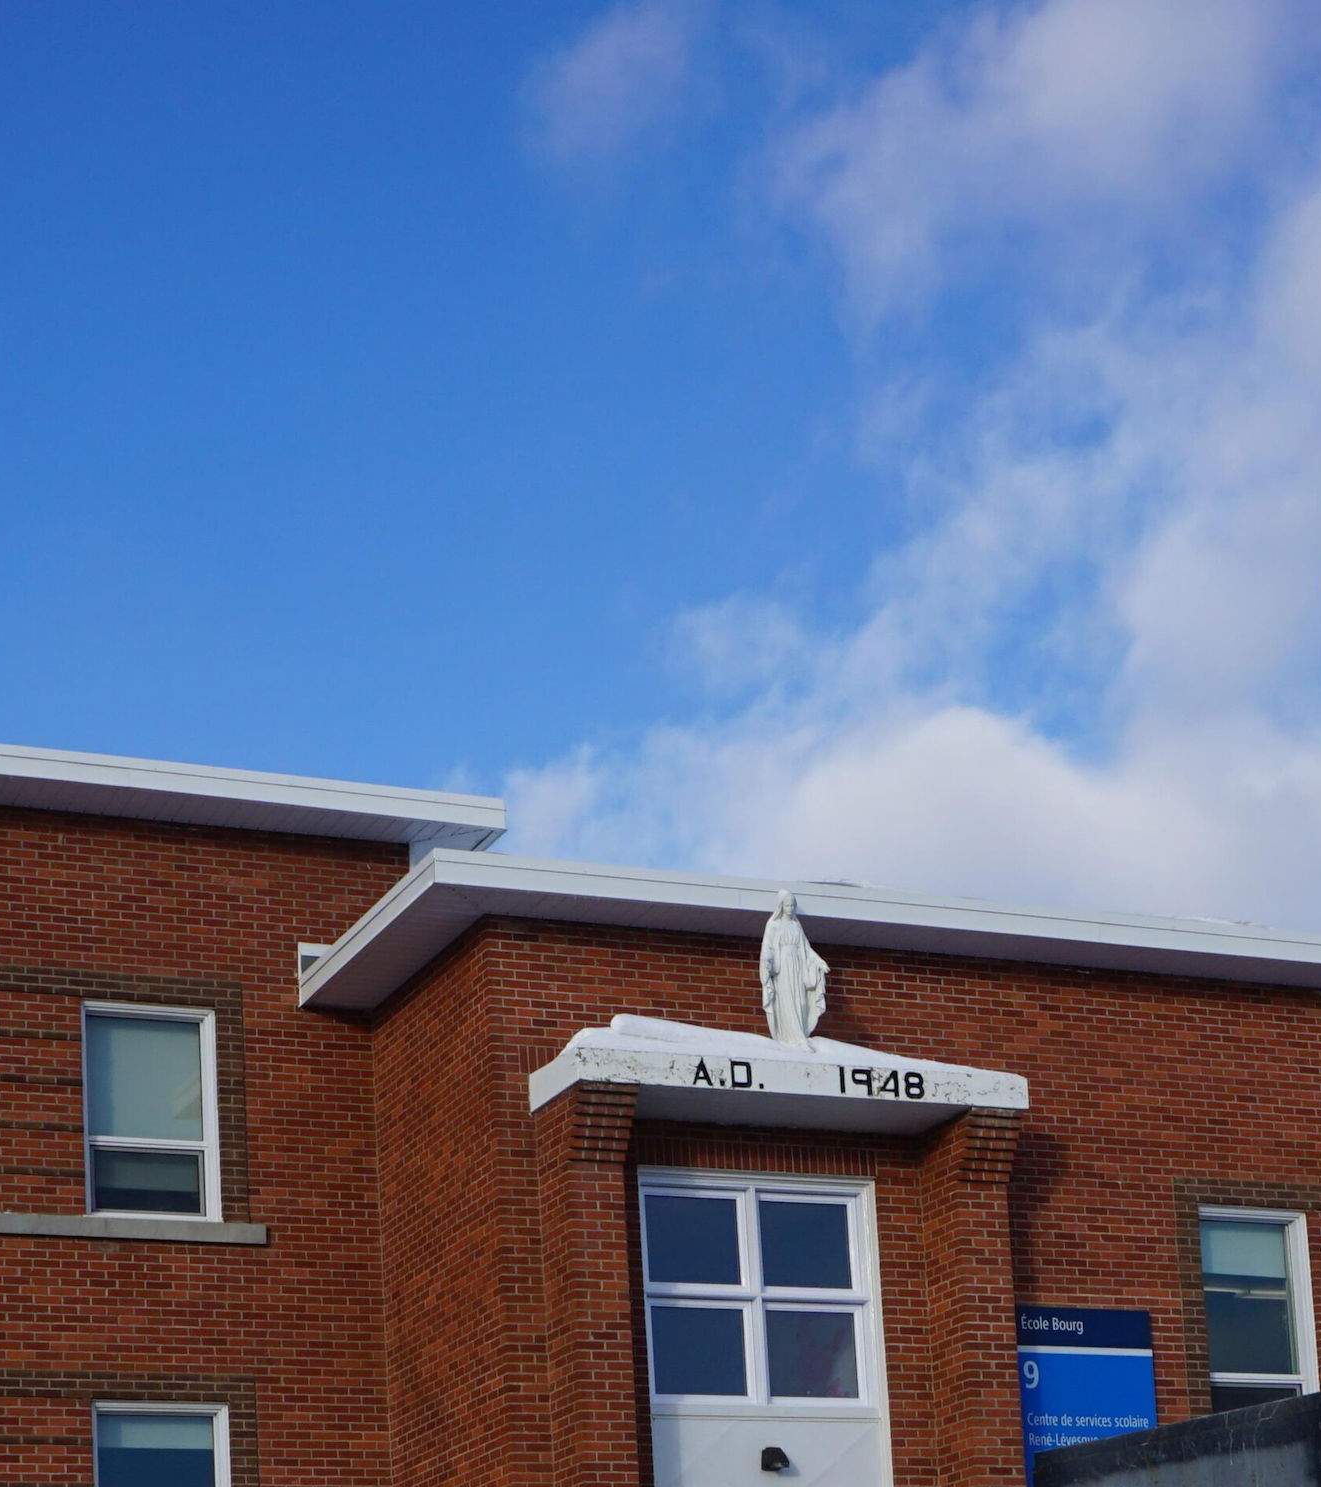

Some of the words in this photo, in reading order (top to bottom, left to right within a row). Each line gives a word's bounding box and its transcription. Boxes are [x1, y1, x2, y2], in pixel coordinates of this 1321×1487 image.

[692, 1057, 765, 1090] A.D.
[839, 1065, 926, 1100] 1948
[1021, 1313, 1049, 1331] École
[1052, 1317, 1084, 1335] Bourg
[1023, 1360, 1040, 1389] 9
[1027, 1412, 1058, 1426] Centre
[1061, 1413, 1073, 1427] de
[1075, 1414, 1112, 1428] services
[1114, 1415, 1149, 1429] scolaire
[1029, 1432, 1100, 1447] René-Léves
